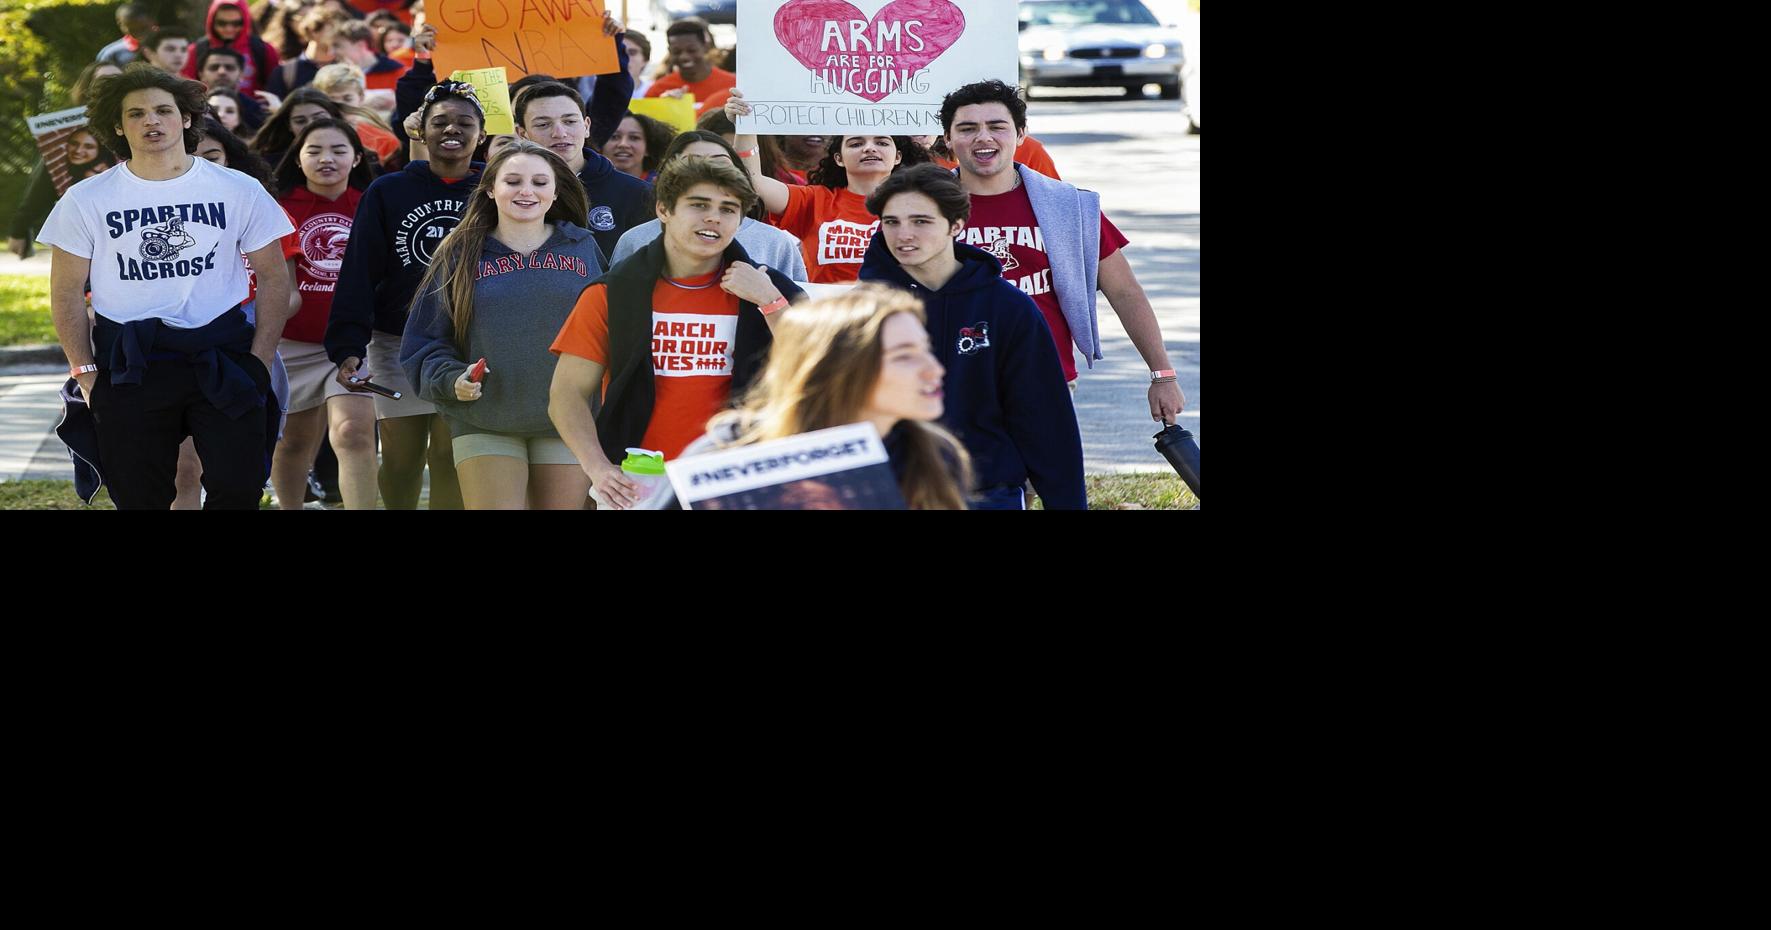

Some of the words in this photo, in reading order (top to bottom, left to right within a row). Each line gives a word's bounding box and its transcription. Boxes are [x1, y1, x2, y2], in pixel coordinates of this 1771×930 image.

[439, 0, 510, 34] GO
[820, 19, 925, 53] ARMS
[480, 28, 599, 75] NRA
[826, 54, 860, 68] ARE
[869, 55, 896, 68] FOR
[810, 68, 930, 95] HUGGING
[738, 104, 832, 125] ROTECT
[835, 106, 921, 128] CHILDREN,
[106, 202, 226, 239] SPARTAN
[401, 200, 464, 229] COUNTRY
[826, 234, 861, 246] FOR
[828, 225, 876, 239] MARC
[395, 230, 412, 267] MIAMI
[825, 247, 864, 259] LIVE
[299, 281, 336, 292] Iceland
[653, 321, 715, 338] ARCH
[651, 340, 677, 353] OR
[680, 341, 728, 355] OUR
[652, 356, 694, 371] VES
[691, 439, 869, 487] #NEVERFORGET
